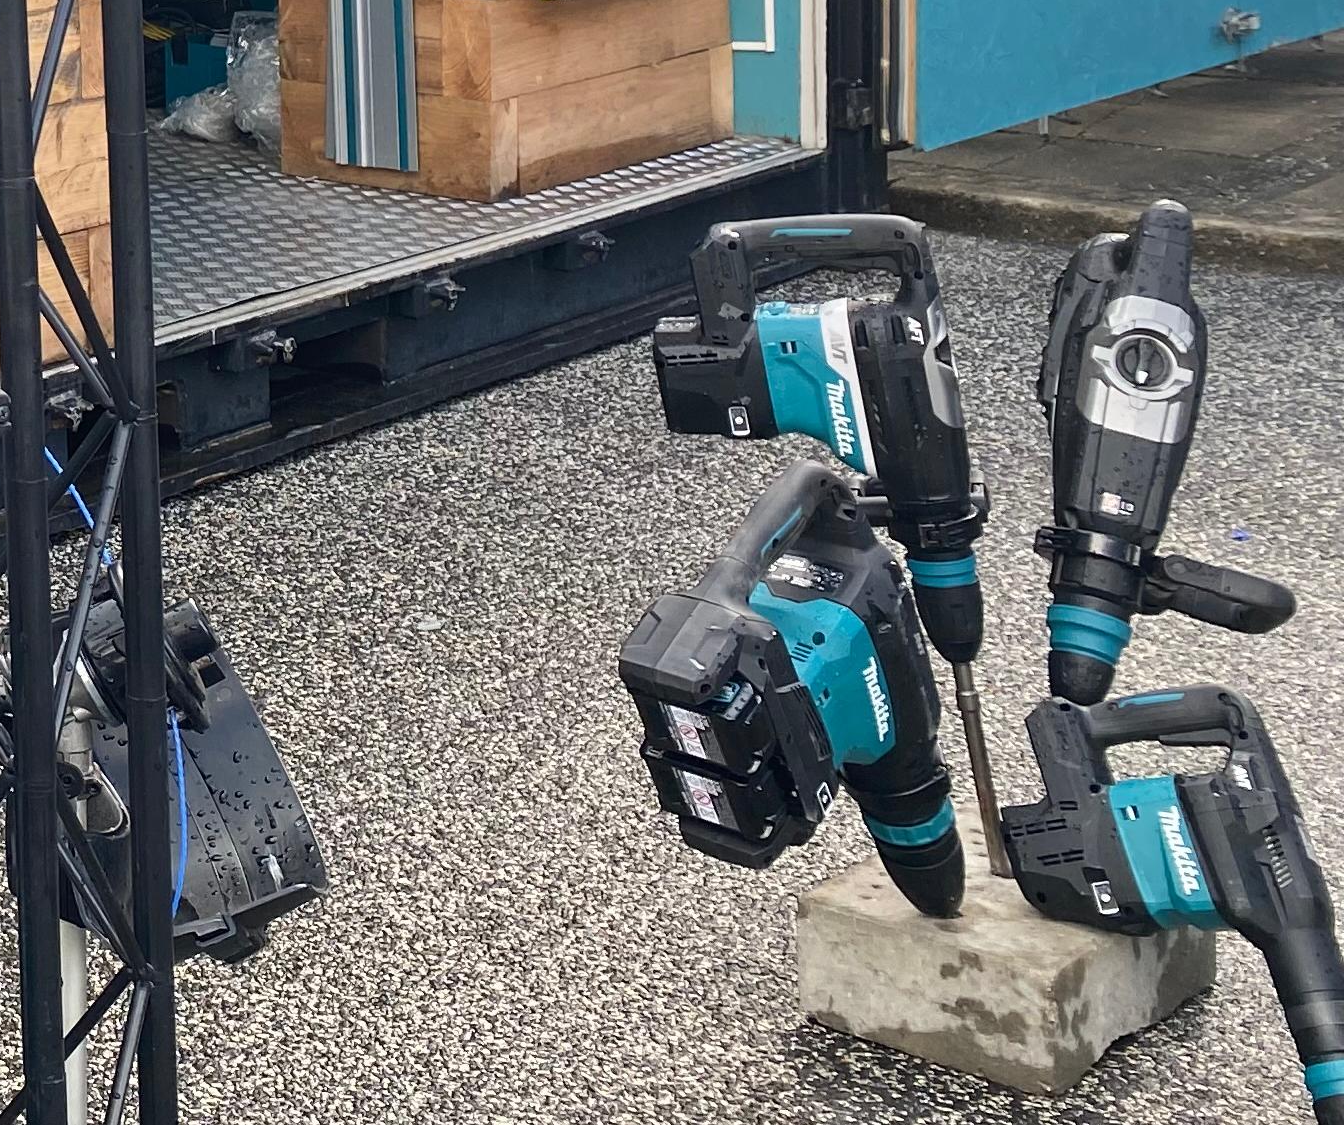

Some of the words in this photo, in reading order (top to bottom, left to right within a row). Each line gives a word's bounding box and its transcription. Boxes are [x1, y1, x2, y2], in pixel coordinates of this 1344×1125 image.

[906, 316, 925, 346] AFT
[826, 379, 856, 457] Makita
[862, 656, 890, 742] Makita
[1157, 805, 1201, 896] Makita
